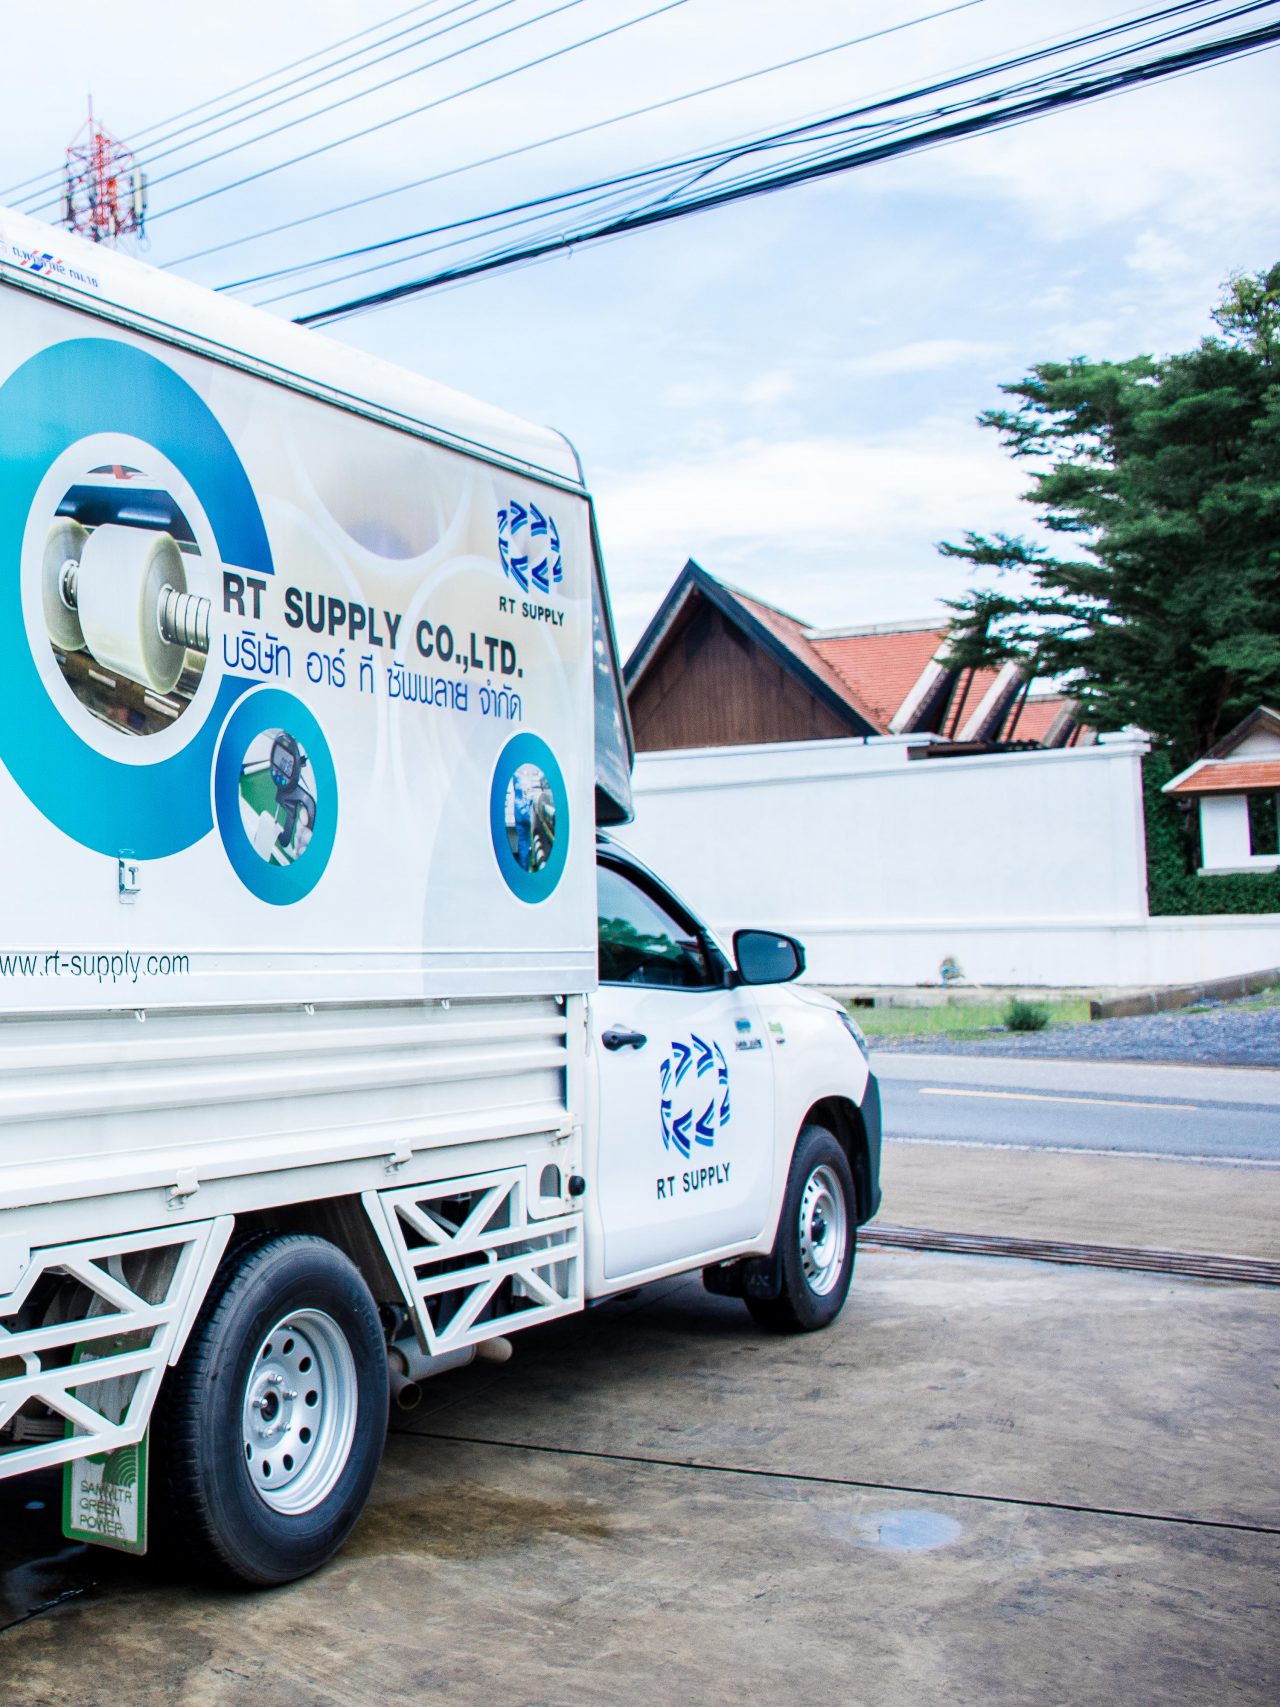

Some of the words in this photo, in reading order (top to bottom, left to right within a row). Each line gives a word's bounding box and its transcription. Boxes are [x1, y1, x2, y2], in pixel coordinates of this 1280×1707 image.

[223, 571, 266, 620] RT
[284, 586, 402, 650] SUPPLY
[416, 620, 523, 678] CO.,LTD.
[499, 596, 516, 614] RT
[522, 602, 564, 627] SUPPLY
[223, 630, 291, 678] บริษัท
[306, 648, 346, 687] อาร์
[360, 654, 374, 693] ที
[387, 661, 468, 711] ซัพพลาย
[479, 679, 522, 721] จำกัด
[657, 1176, 675, 1200] RT
[682, 1162, 731, 1193] SUPPLY
[80, 1498, 120, 1518] GREEN
[80, 1514, 125, 1537] POWER
